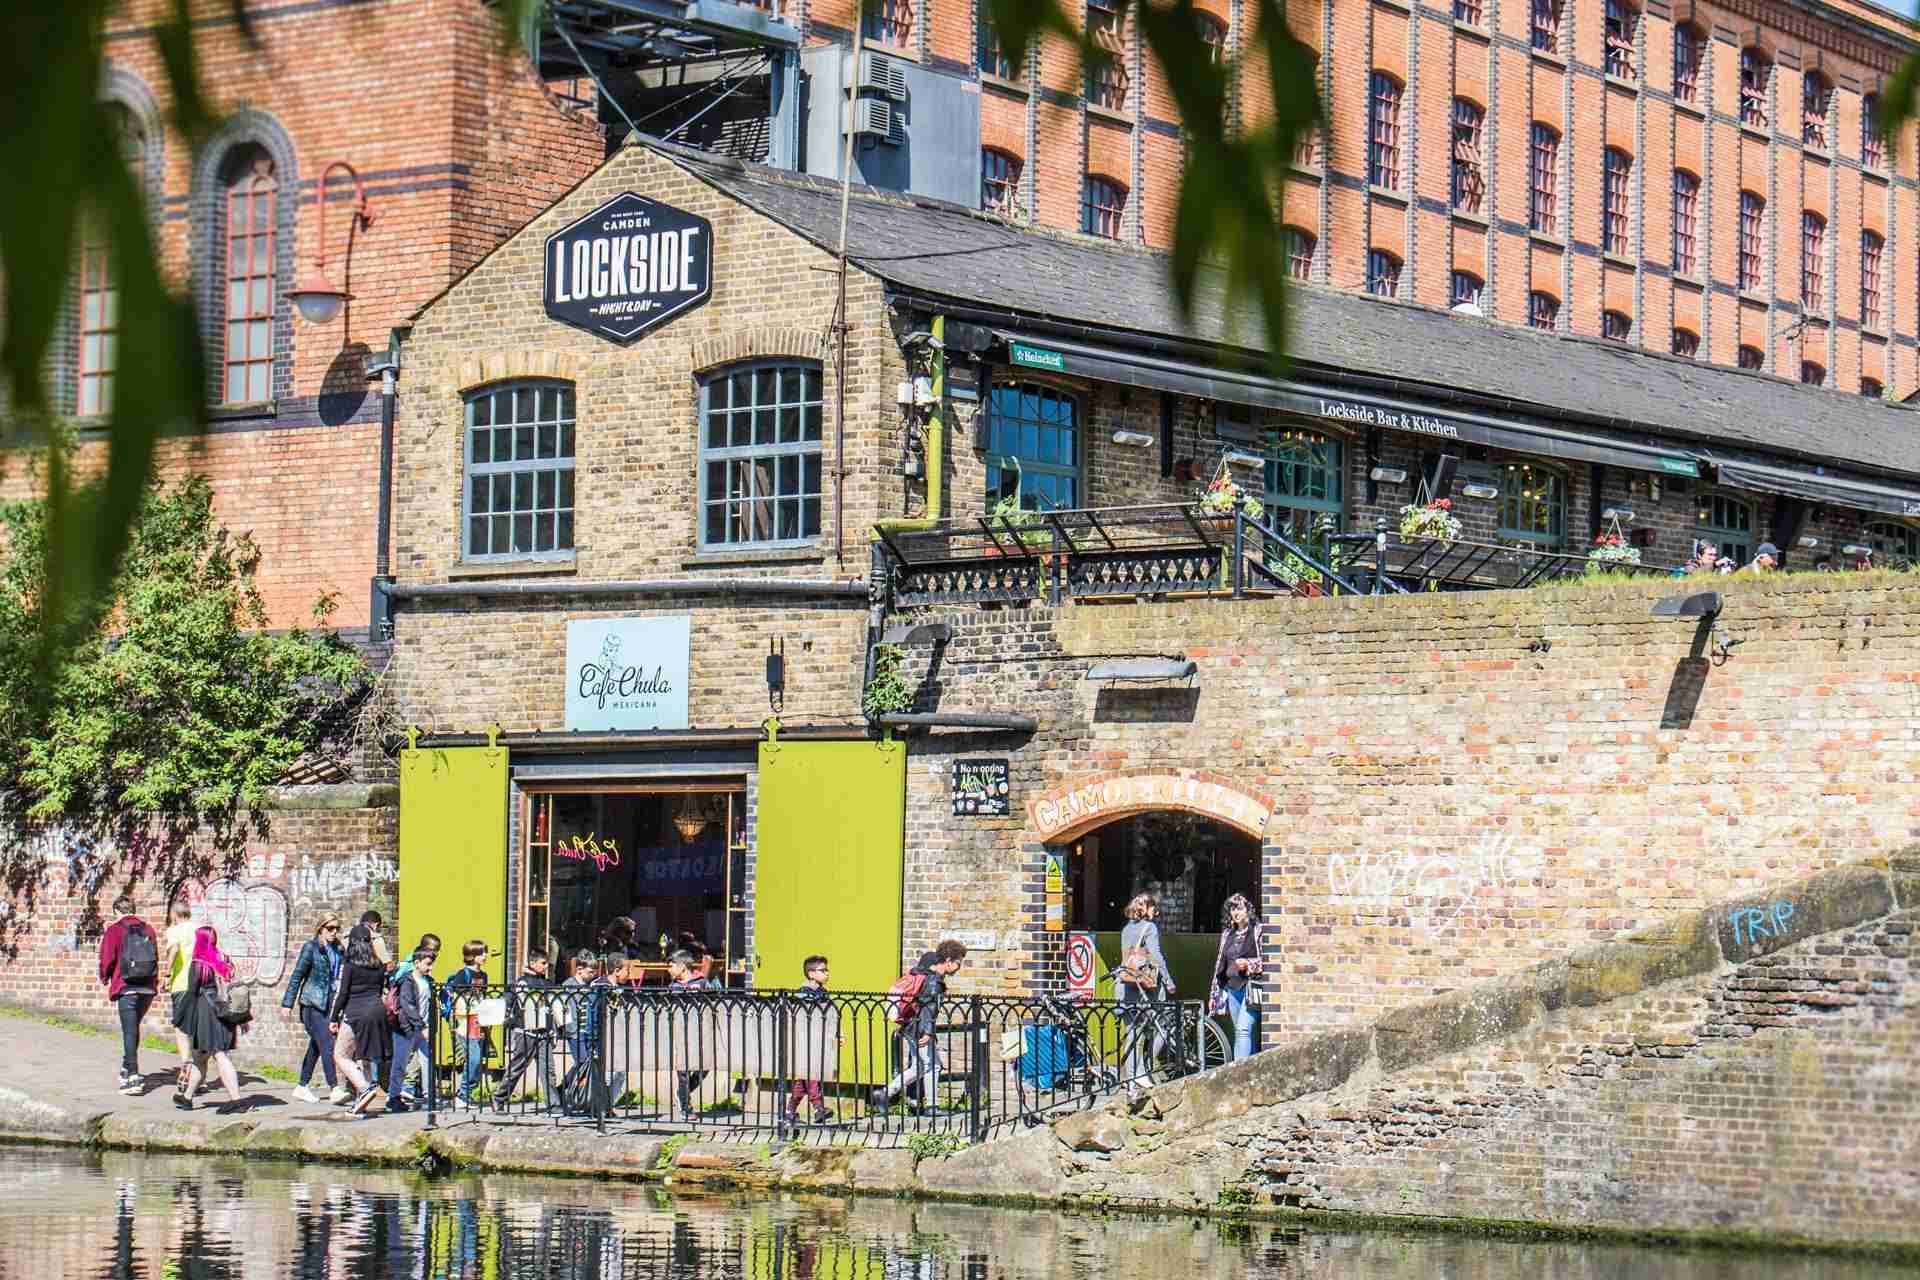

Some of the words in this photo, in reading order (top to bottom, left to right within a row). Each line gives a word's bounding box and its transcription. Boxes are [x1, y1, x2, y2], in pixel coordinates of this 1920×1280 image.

[602, 217, 651, 231] CAMDEN
[555, 227, 699, 303] LOCKSIDE
[1319, 400, 1375, 424] Lockside
[1376, 409, 1399, 427] Bar
[1400, 414, 1410, 430] &
[1411, 415, 1458, 438] Kitchen
[612, 701, 657, 709] MEXICANA
[960, 763, 972, 774] No
[1728, 899, 1794, 945] TRIP
